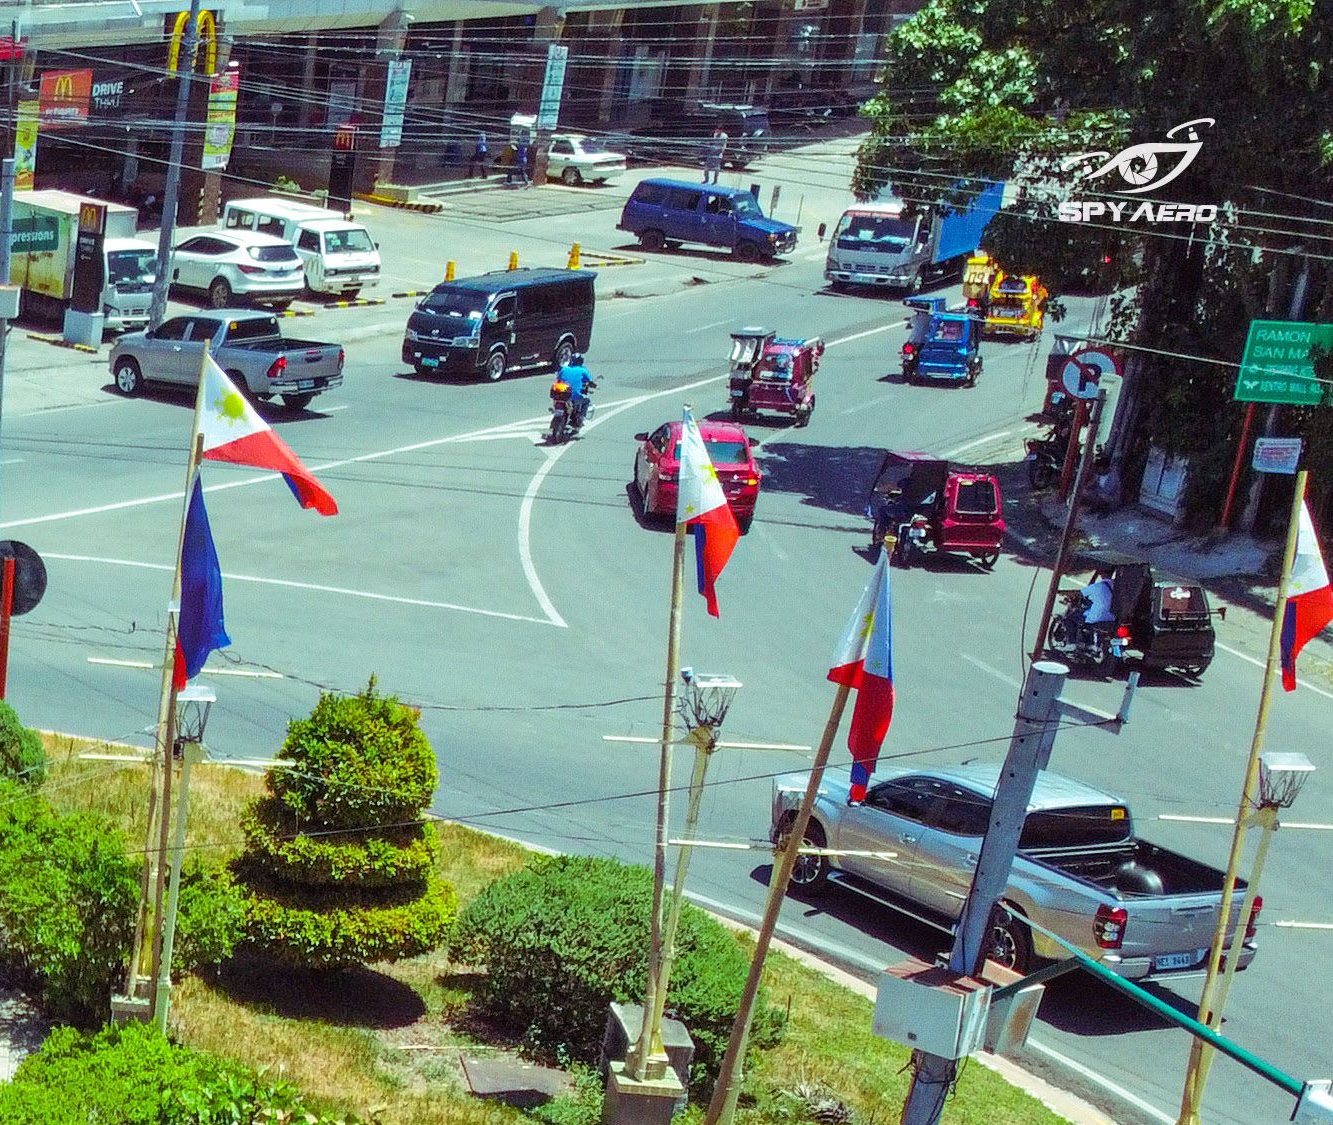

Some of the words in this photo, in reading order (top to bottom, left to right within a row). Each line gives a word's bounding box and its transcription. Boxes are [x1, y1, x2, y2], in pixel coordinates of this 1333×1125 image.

[92, 82, 124, 96] DRIVE
[1255, 329, 1311, 343] RAMON
[1252, 345, 1285, 359] SAN
